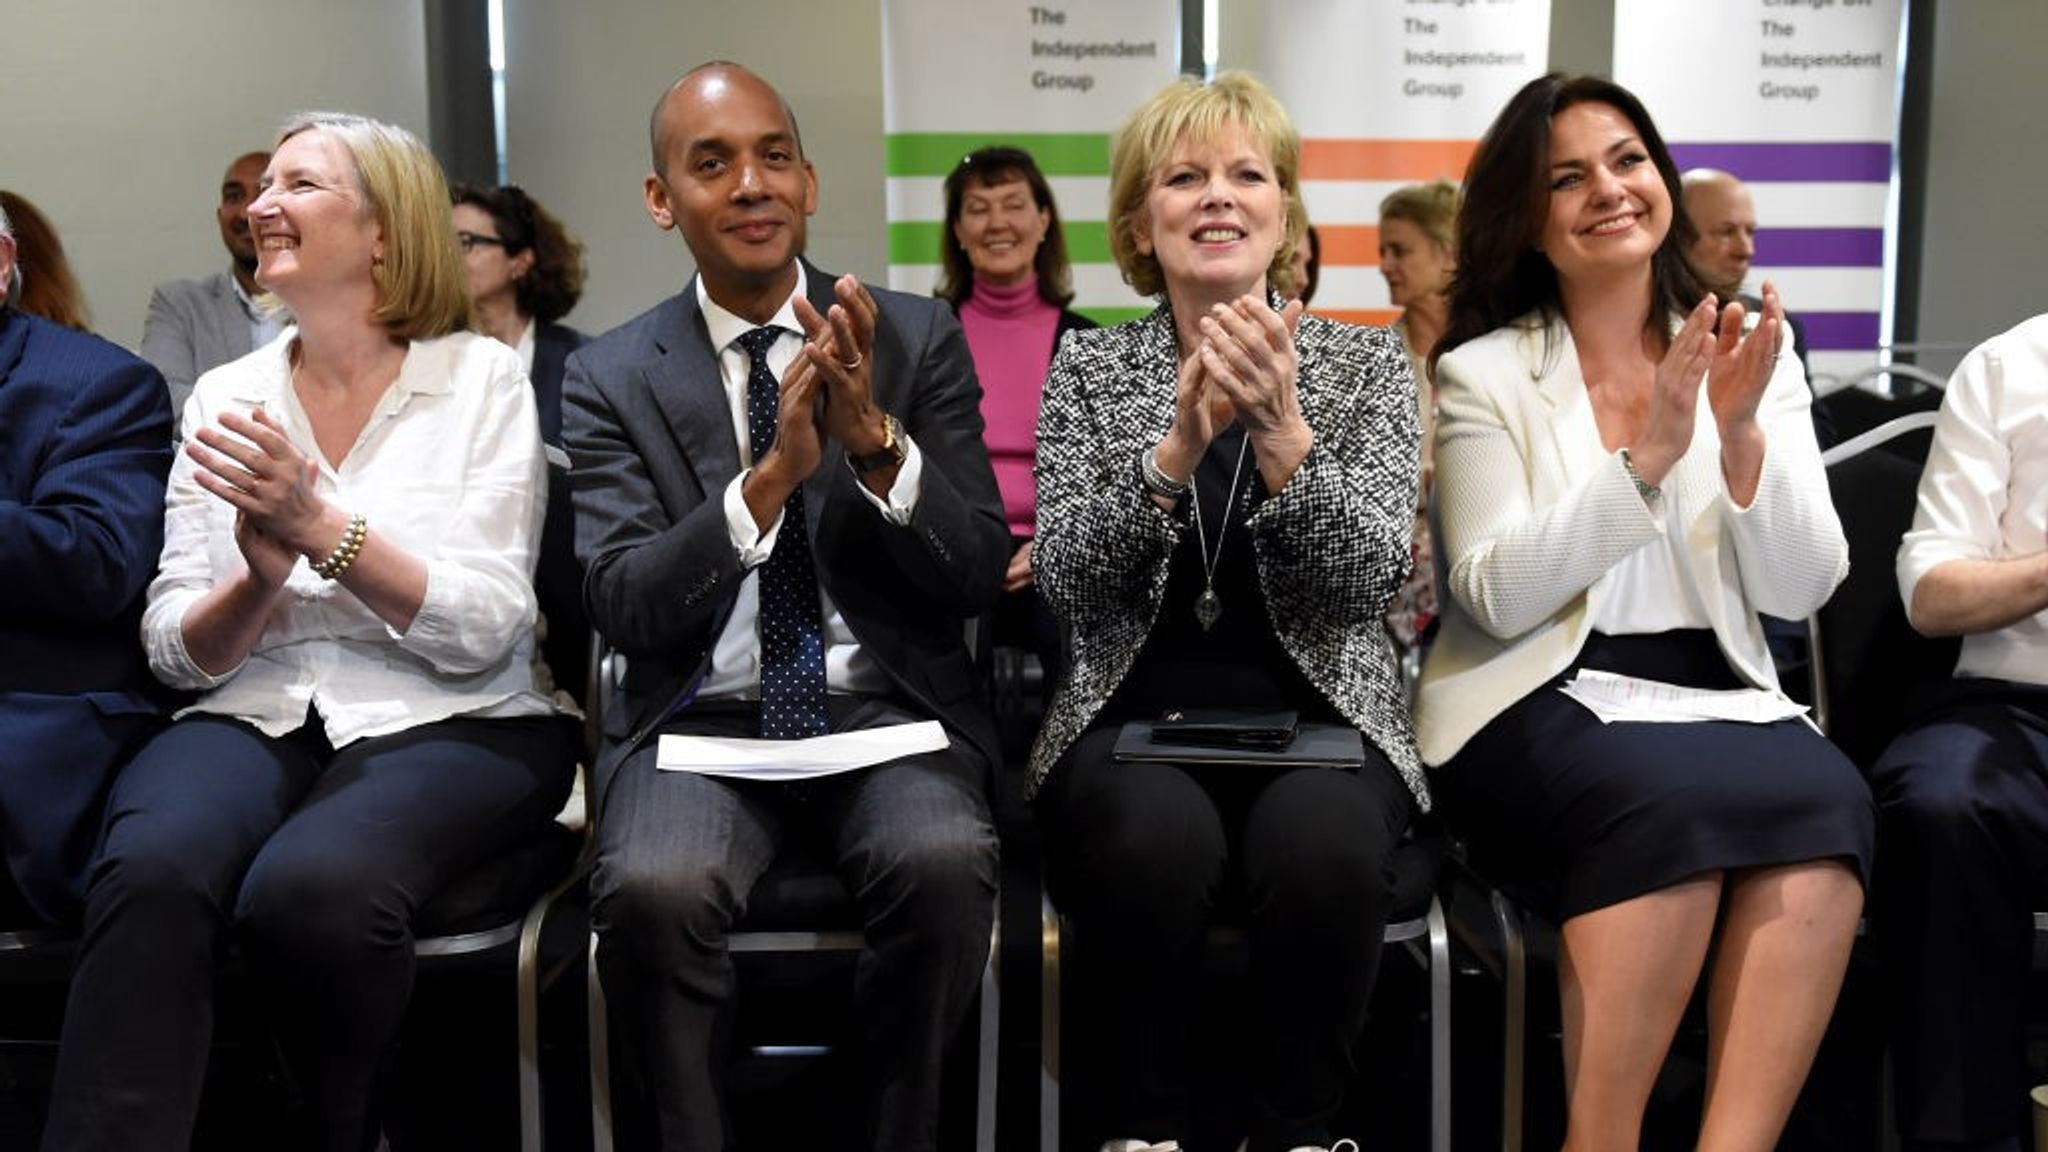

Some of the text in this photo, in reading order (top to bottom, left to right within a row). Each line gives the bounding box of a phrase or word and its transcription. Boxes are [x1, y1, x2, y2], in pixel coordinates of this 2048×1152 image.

[1030, 7, 1066, 25] The
[1404, 18, 1438, 34] The
[1760, 20, 1794, 37] The
[1031, 40, 1156, 60] Independent
[1404, 50, 1526, 67] Independent
[1760, 52, 1882, 69] Independent
[1031, 70, 1094, 93] Group
[1403, 79, 1464, 98] Group
[1759, 81, 1820, 100] Group
